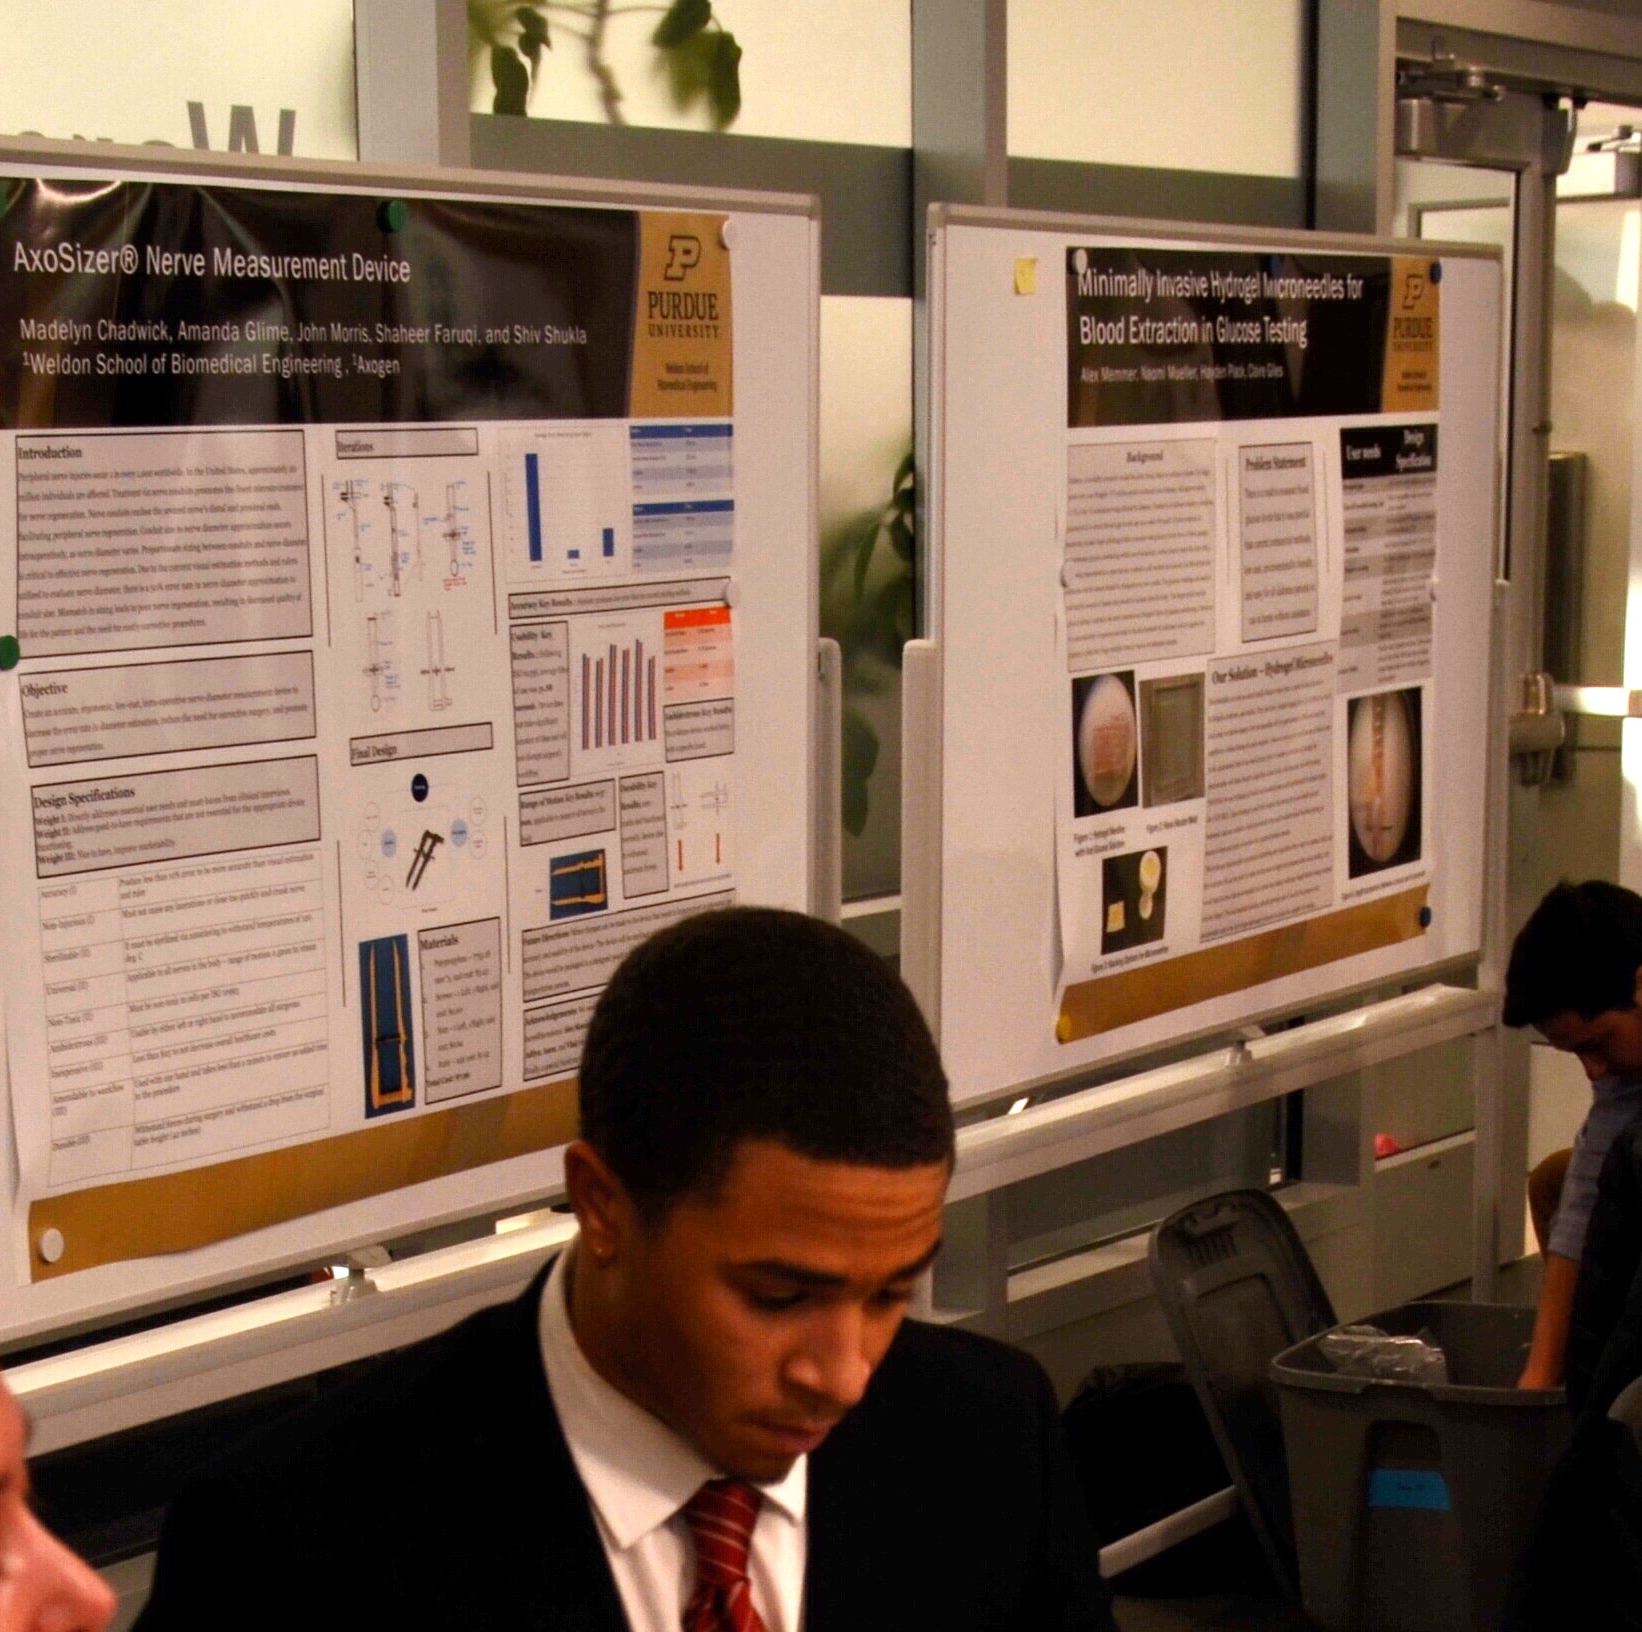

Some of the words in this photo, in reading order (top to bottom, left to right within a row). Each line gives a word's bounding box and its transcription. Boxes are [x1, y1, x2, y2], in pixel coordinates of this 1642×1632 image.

[13, 241, 139, 275] AxoSizer®
[146, 245, 206, 276] Nerve
[213, 247, 349, 281] Measurement
[352, 252, 412, 283] Device
[1078, 268, 1154, 303] Minimally
[1157, 269, 1209, 298] Invasive
[1211, 269, 1259, 305] Hydrogel
[1346, 272, 1363, 300] for
[647, 290, 719, 321] PURDUE
[19, 318, 92, 346] Madelyn
[97, 318, 173, 344] Chadwick,
[177, 320, 240, 343] Amanda
[244, 320, 294, 344] Glime,
[296, 322, 327, 343] John
[330, 322, 373, 345] Morris,
[375, 323, 431, 344] Shaheer
[434, 323, 482, 347] Faruqi,
[485, 324, 510, 345] and
[513, 324, 541, 345] Shiv
[544, 324, 588, 345] Shukla
[648, 324, 720, 339] UNIVERSITY
[1079, 314, 1126, 345] Blood
[1129, 314, 1198, 345] Extraction
[1201, 314, 1214, 344] in
[1216, 314, 1262, 344] Glucose
[1264, 314, 1308, 349] Testing
[1393, 316, 1433, 339] PURDUE
[96, 352, 148, 375] School
[151, 352, 169, 374] of
[171, 352, 257, 375] Biomedical
[262, 353, 342, 379] Engineering
[1080, 365, 1099, 382] Alex
[17, 445, 83, 461] Introduction
[21, 681, 69, 699] Objective
[372, 744, 398, 758] Design
[33, 795, 67, 811] Design
[68, 786, 136, 807] Specifications
[419, 934, 460, 950] Materials
